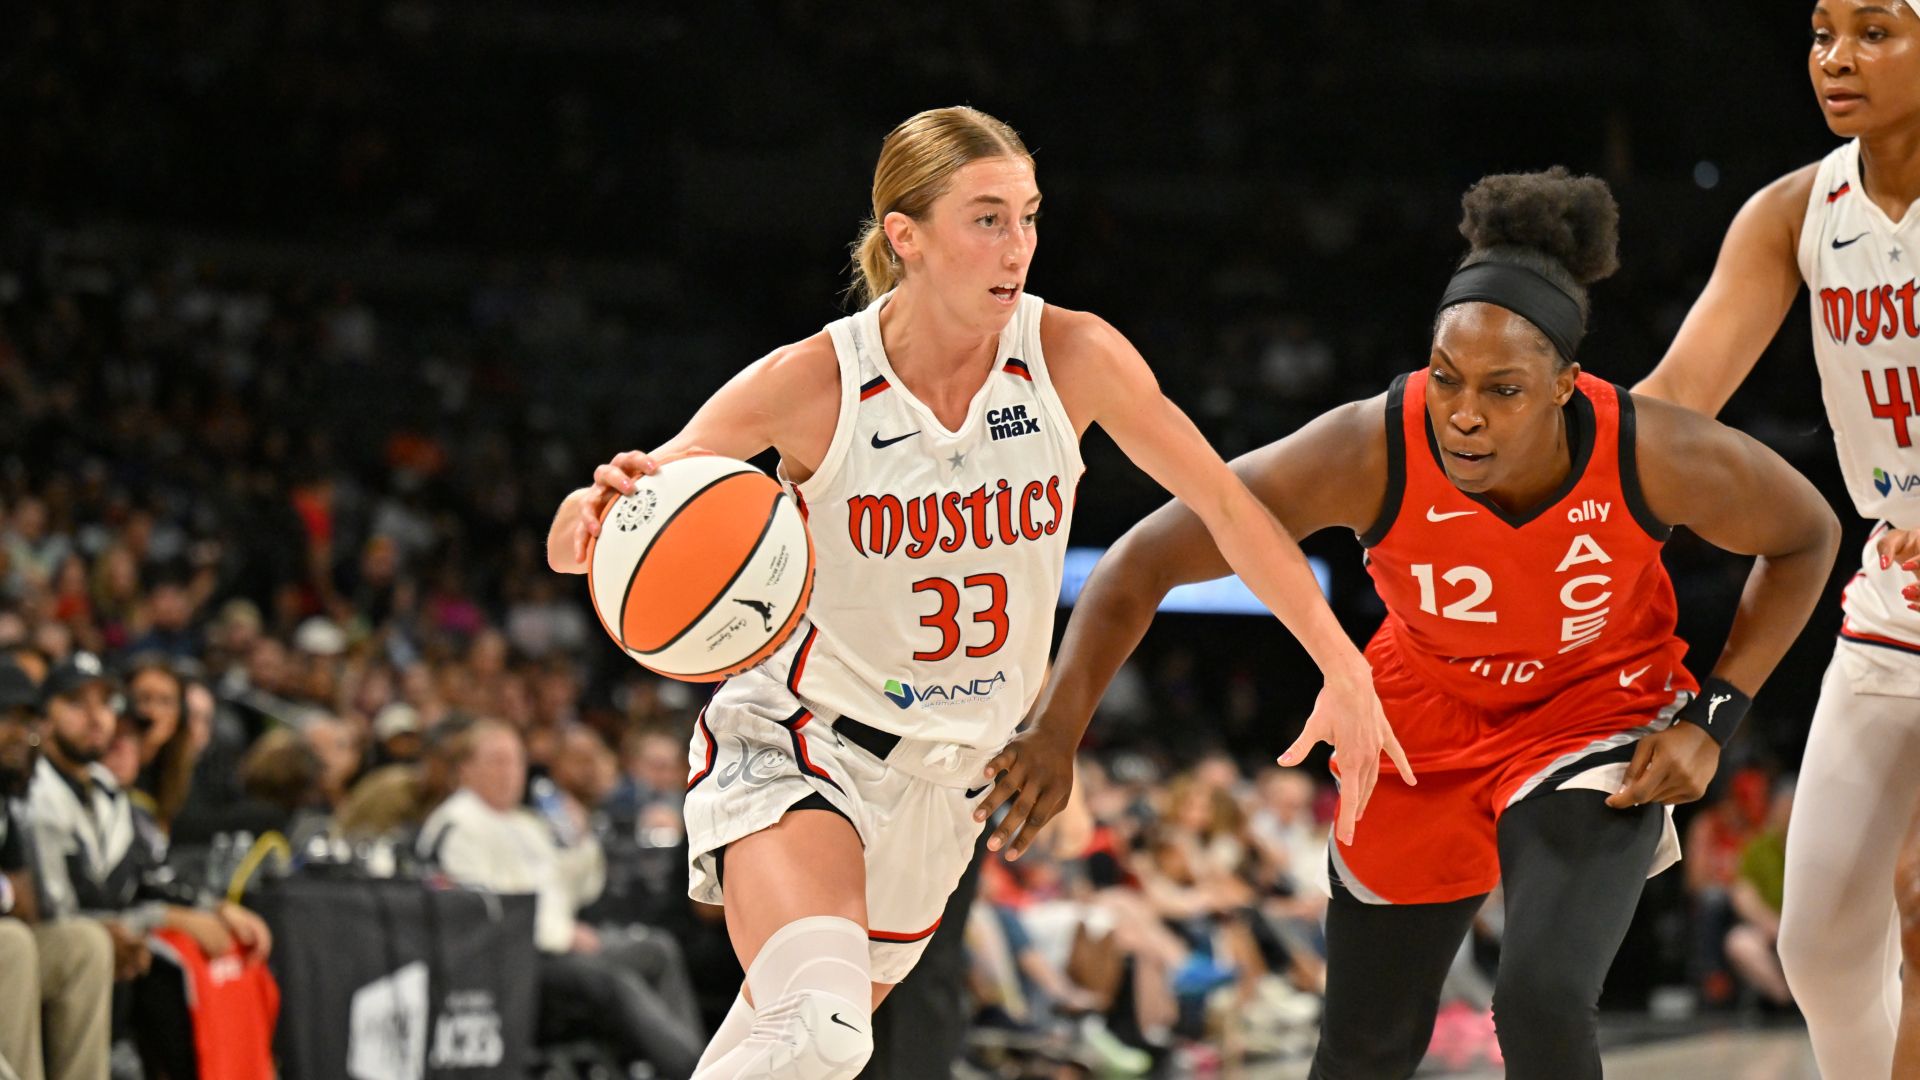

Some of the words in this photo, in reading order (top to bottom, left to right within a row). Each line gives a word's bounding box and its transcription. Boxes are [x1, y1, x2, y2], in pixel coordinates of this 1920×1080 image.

[986, 404, 1028, 425] CAR
[990, 417, 1041, 441] max
[1861, 366, 1920, 448] 4
[1567, 499, 1611, 523] ally
[912, 572, 1010, 662] 33
[1410, 563, 1497, 624] 12
[1554, 533, 1613, 654] ACE
